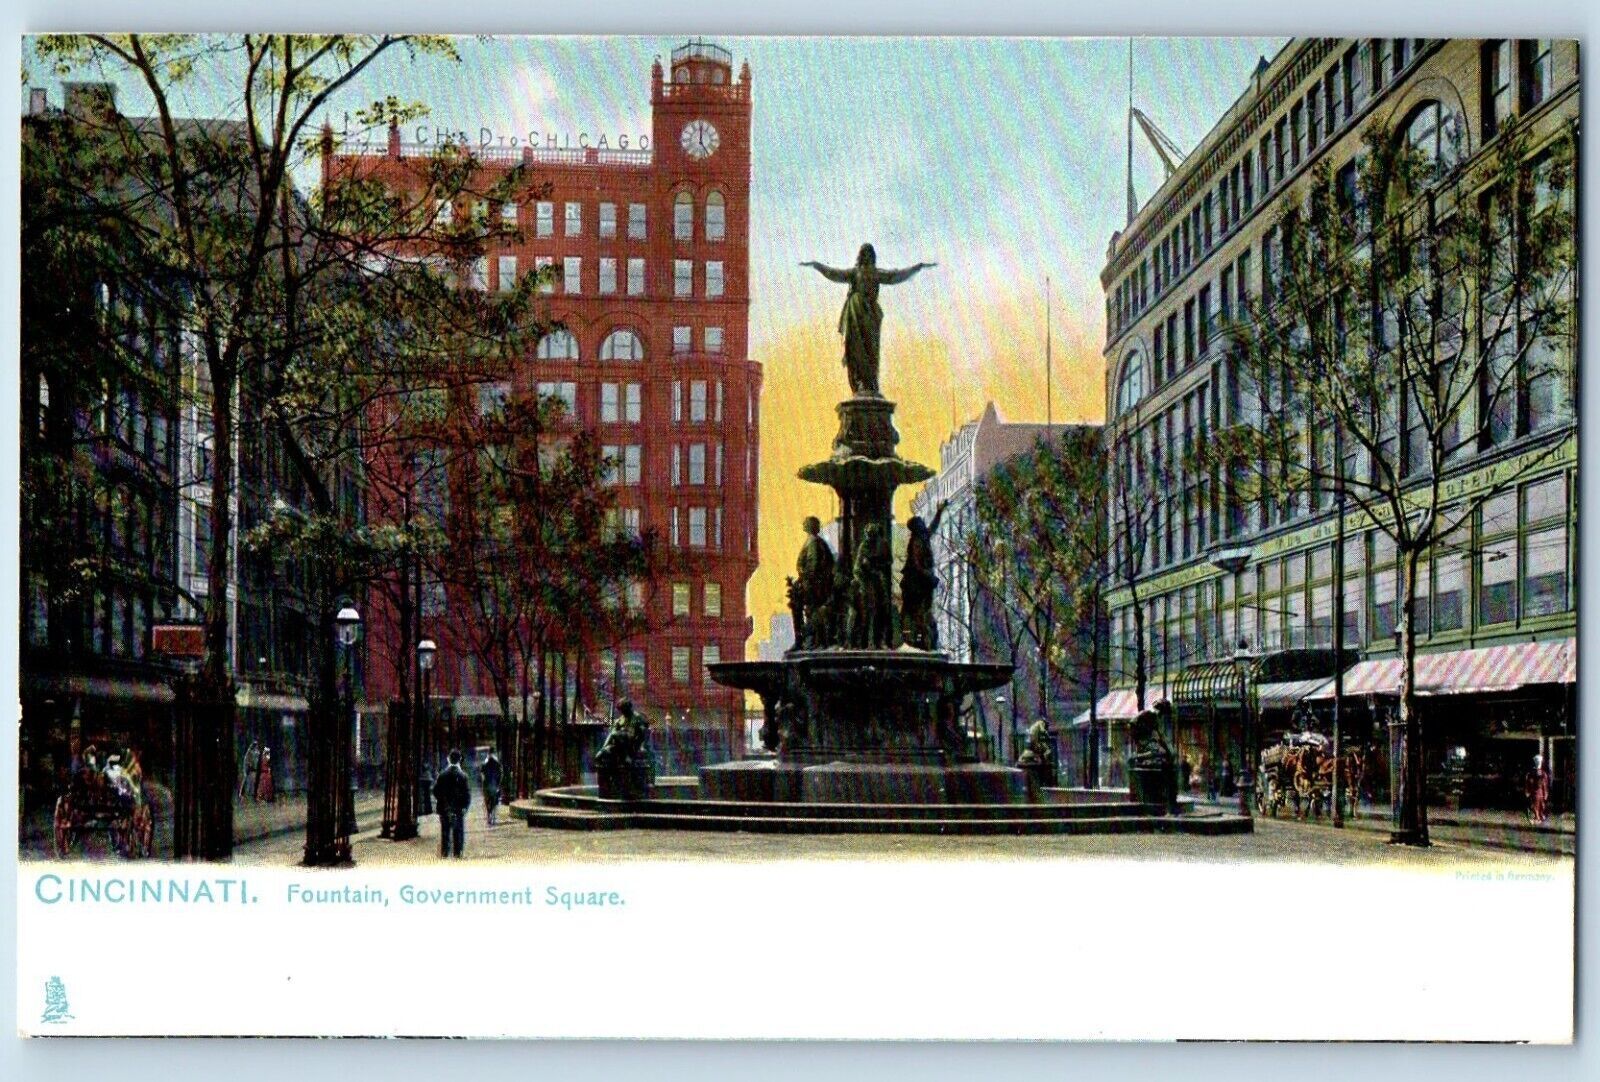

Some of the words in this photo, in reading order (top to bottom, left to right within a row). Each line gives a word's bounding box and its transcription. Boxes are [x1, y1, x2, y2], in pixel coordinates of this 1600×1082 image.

[1455, 870, 1492, 881] Printed
[1495, 870, 1505, 881] in
[35, 873, 258, 905] CINCINNATI.
[287, 884, 389, 908] Fountain,
[399, 884, 533, 906] Government
[545, 885, 626, 911] Square.
